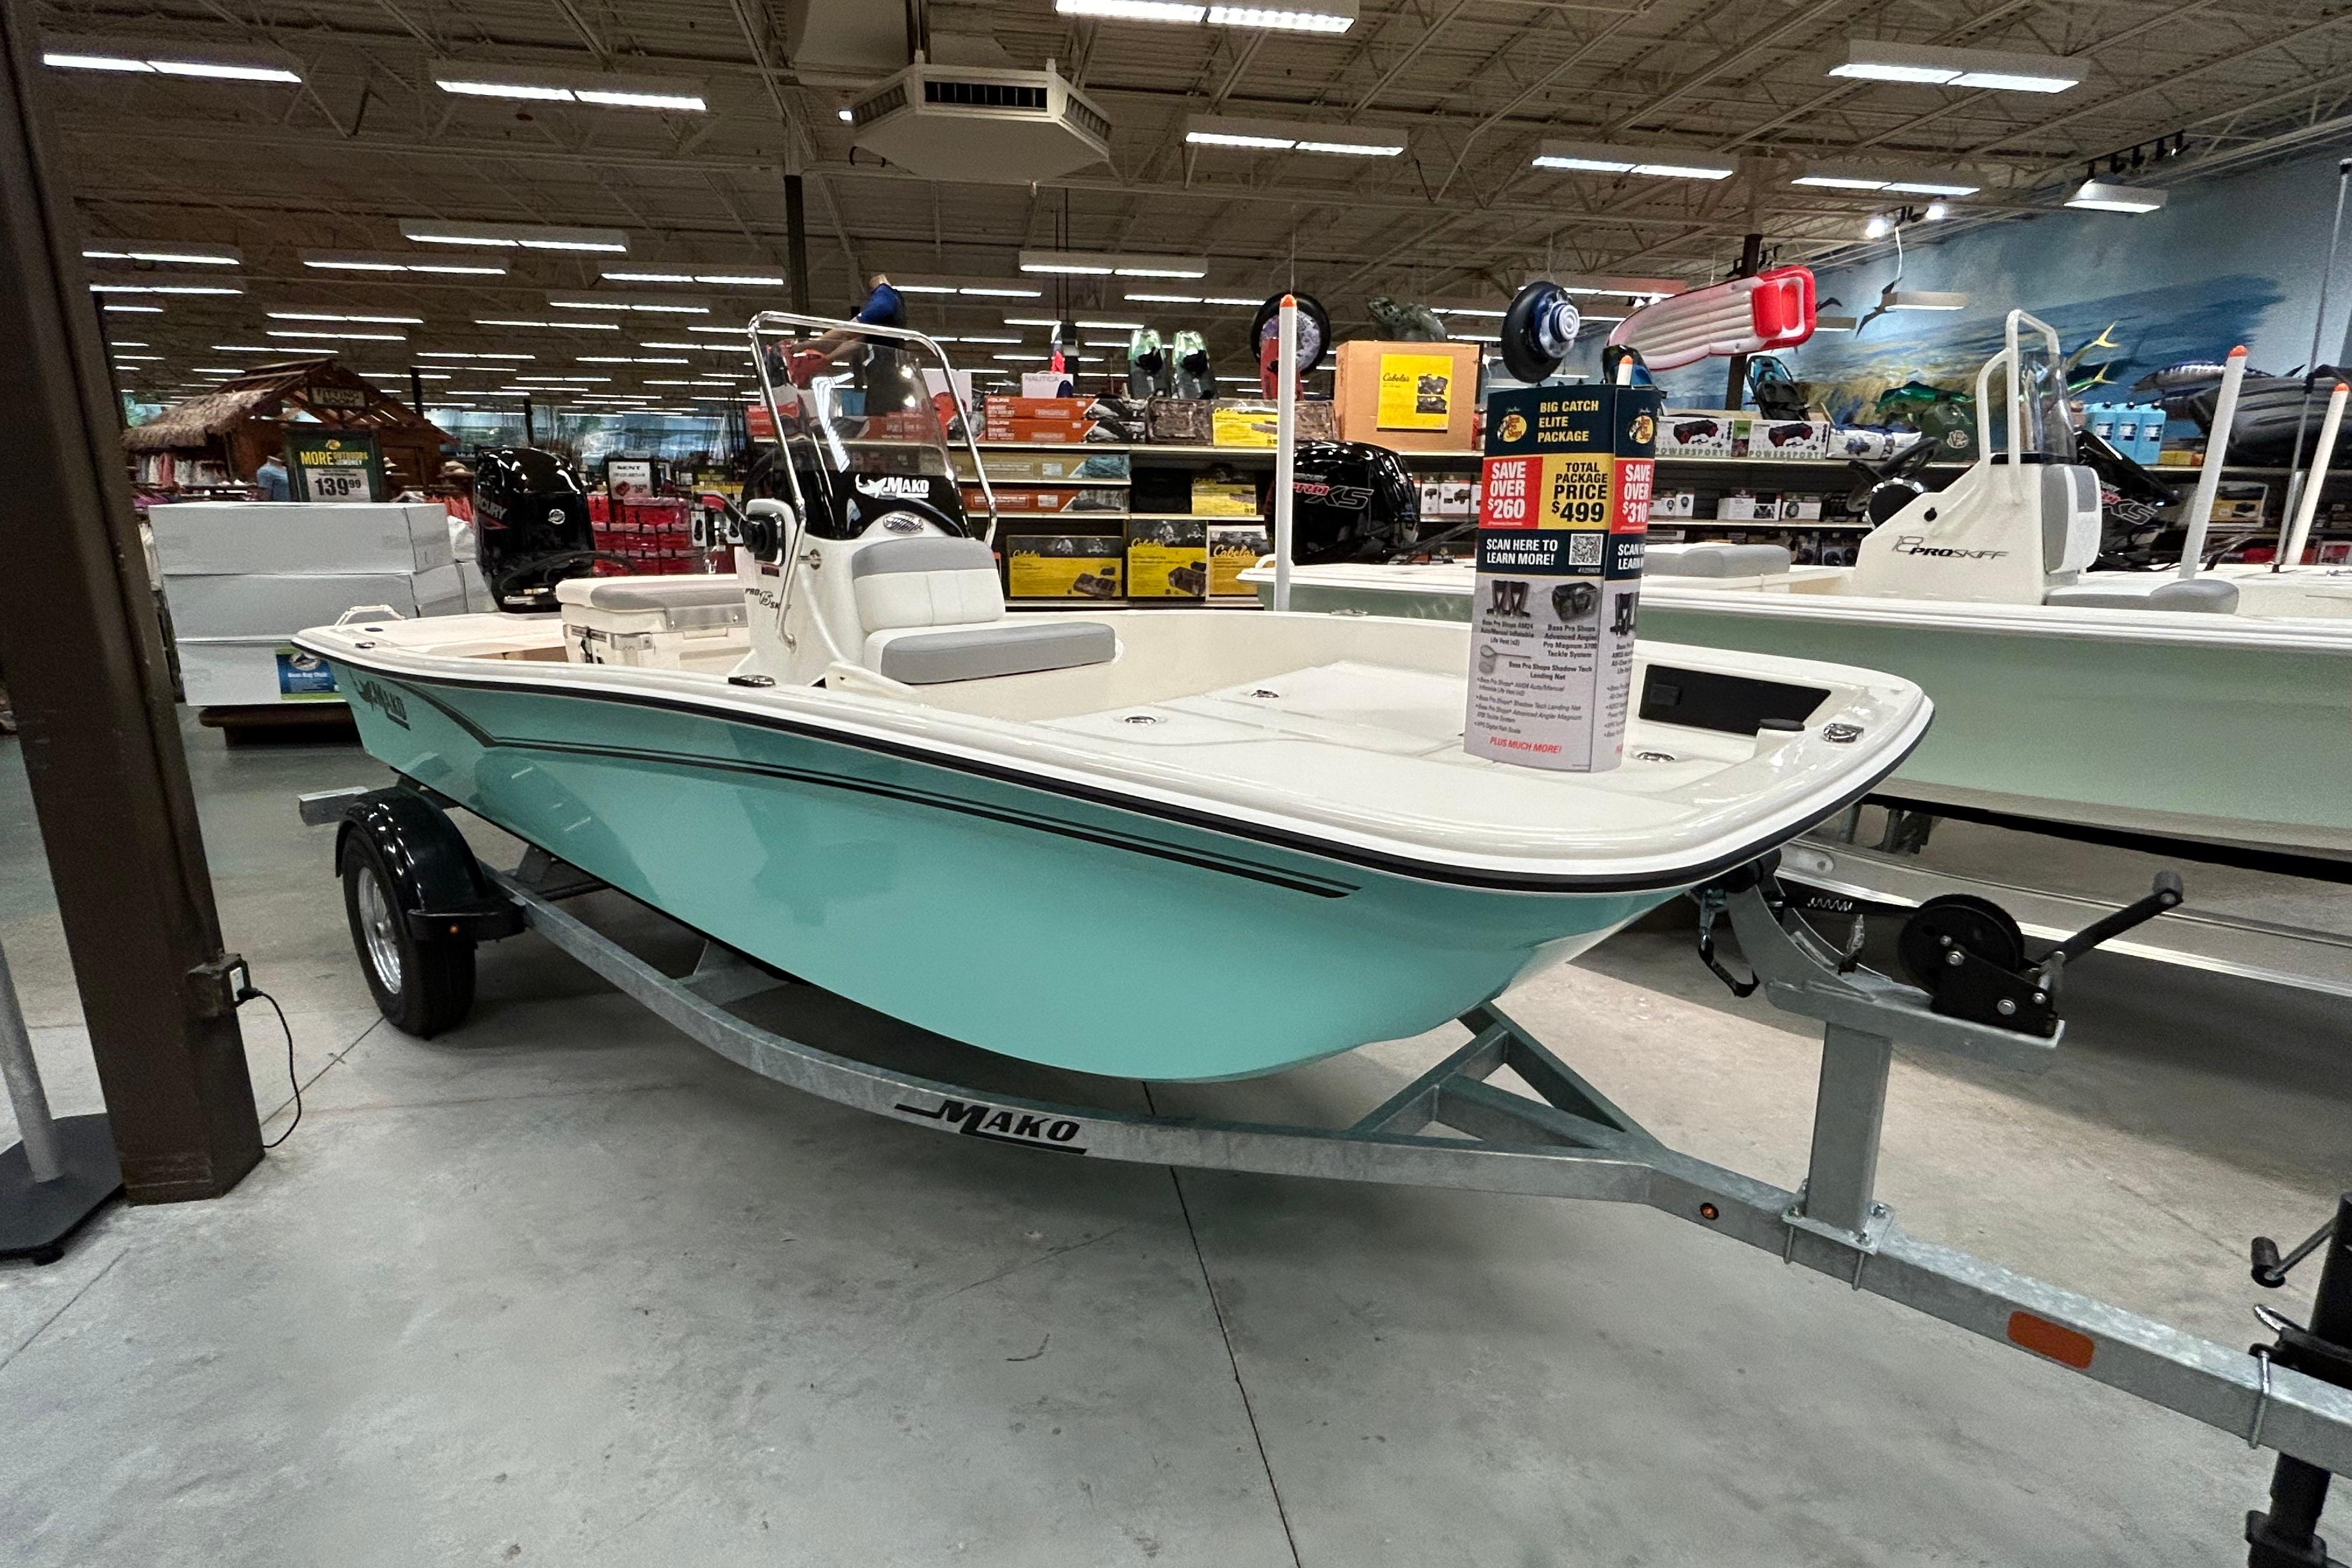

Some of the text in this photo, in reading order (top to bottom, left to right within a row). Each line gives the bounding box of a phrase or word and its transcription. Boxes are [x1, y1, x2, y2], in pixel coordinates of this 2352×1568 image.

[1540, 400, 1599, 412] BIG CATCH
[1539, 416, 1569, 428] ELITE
[1538, 431, 1589, 442] PACKAGE
[300, 451, 334, 465] MORE
[1750, 450, 1825, 459] POWERSPORTS
[1492, 461, 1526, 480] SAVE
[1566, 463, 1600, 473] TOTAL
[1625, 464, 1650, 482] SAVE
[1555, 474, 1608, 484] PACKAGE
[883, 477, 930, 498] MAKO
[1490, 480, 1525, 497] OVER
[1554, 484, 1606, 499] PRICE
[1624, 483, 1648, 500] OVER
[1305, 485, 1374, 509] XS
[1488, 499, 1525, 519] $260
[1552, 501, 1604, 522] $499
[1622, 502, 1646, 523] $310
[1213, 544, 1255, 557] Cabela's
[1487, 538, 1558, 551] SCAN HERE TO
[1618, 544, 1639, 556] SCAN
[1487, 552, 1555, 565] LEARN MORE!
[1530, 673, 1553, 681] Landing
[1490, 736, 1562, 754] PLUS MUCH MORE!
[928, 1100, 1087, 1154] MAKO
